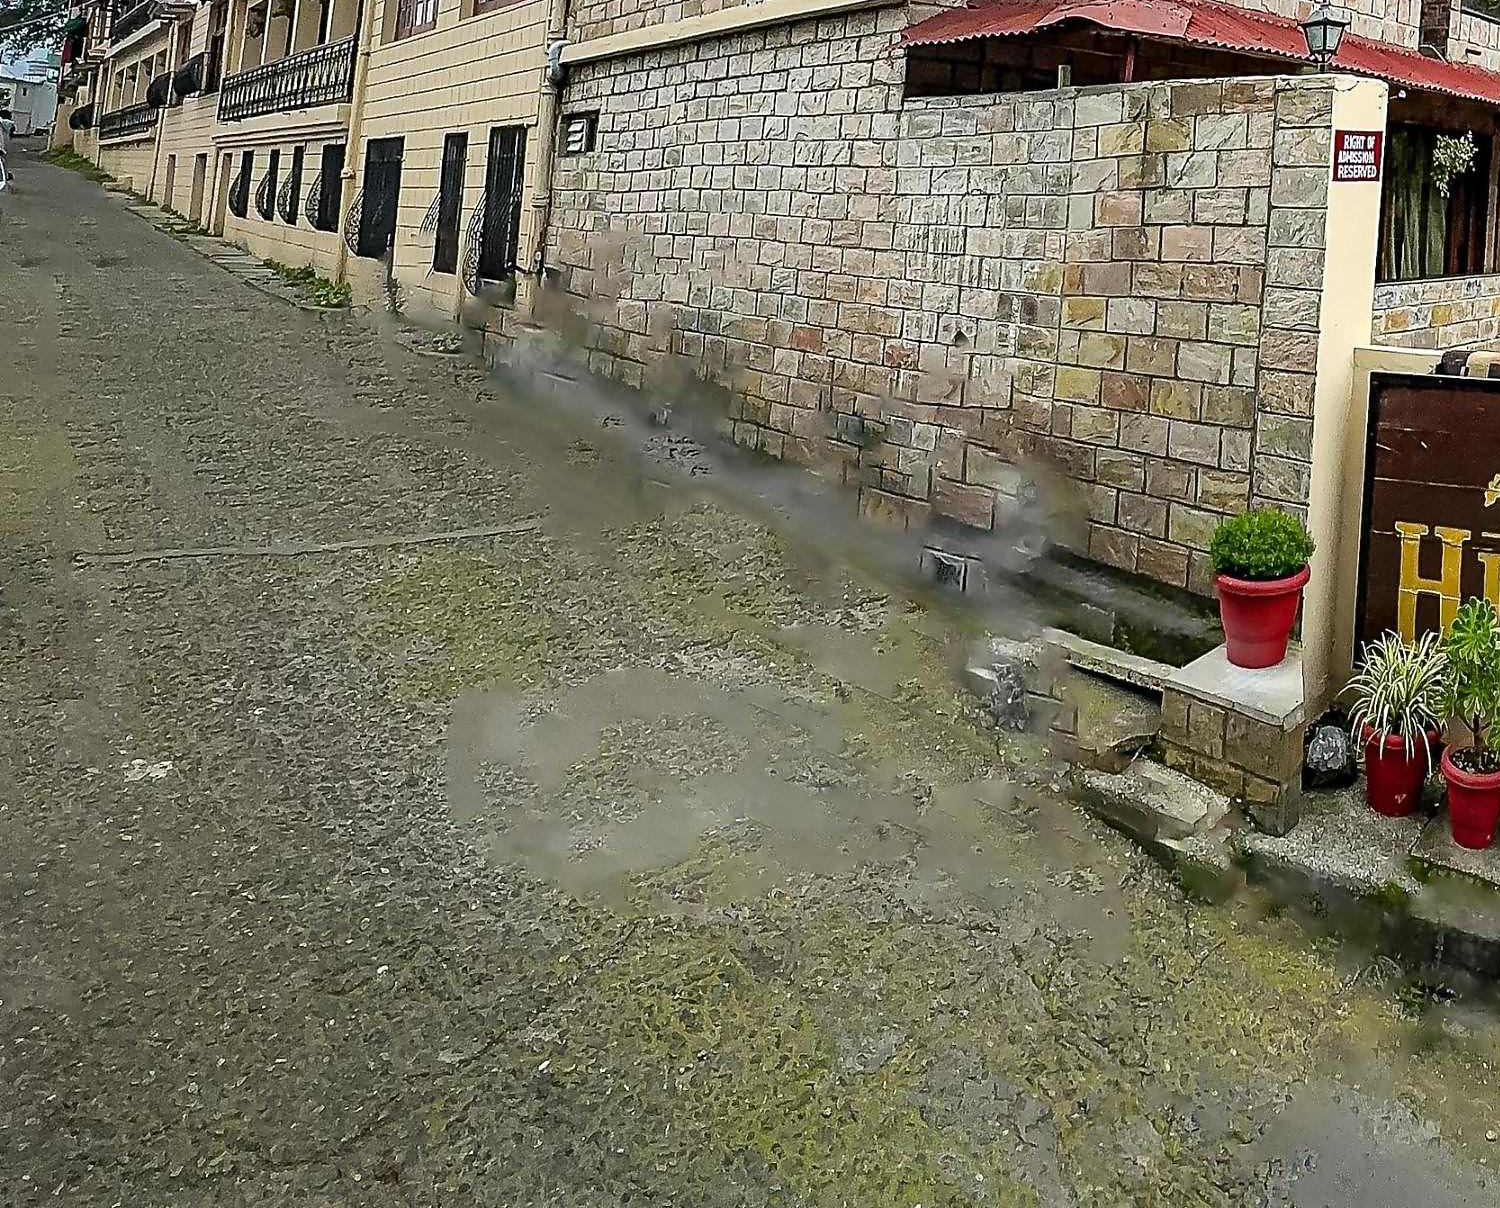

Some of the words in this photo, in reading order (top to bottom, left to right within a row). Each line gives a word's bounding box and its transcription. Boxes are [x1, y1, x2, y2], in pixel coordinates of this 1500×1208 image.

[1343, 134, 1366, 150] RIGHT
[1366, 135, 1376, 150] OF
[1337, 150, 1375, 164] ADMISSION
[1337, 164, 1377, 179] RESERVED
